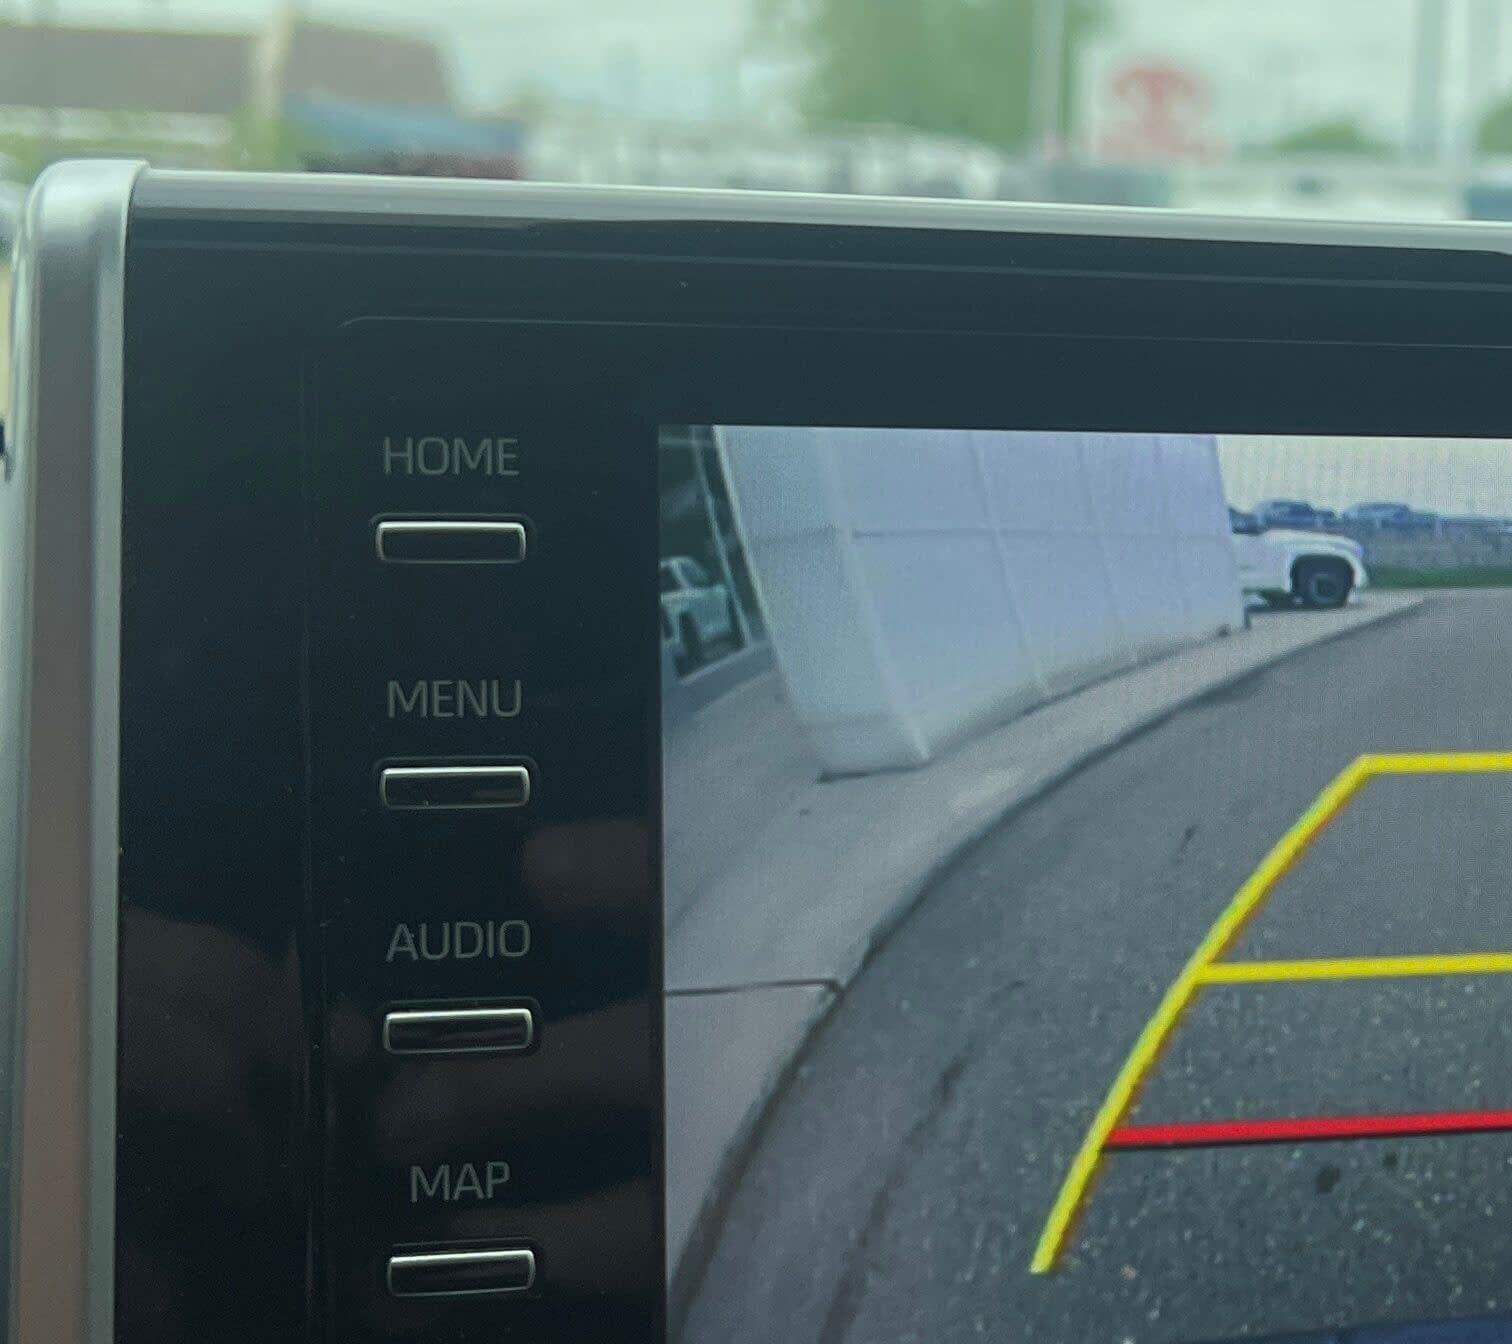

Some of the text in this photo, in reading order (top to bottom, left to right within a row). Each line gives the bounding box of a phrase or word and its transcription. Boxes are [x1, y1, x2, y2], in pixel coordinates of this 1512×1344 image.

[383, 436, 520, 476] HOME
[387, 679, 522, 719] MENU
[386, 920, 532, 962] AUDIO
[409, 1161, 512, 1203] MAP
